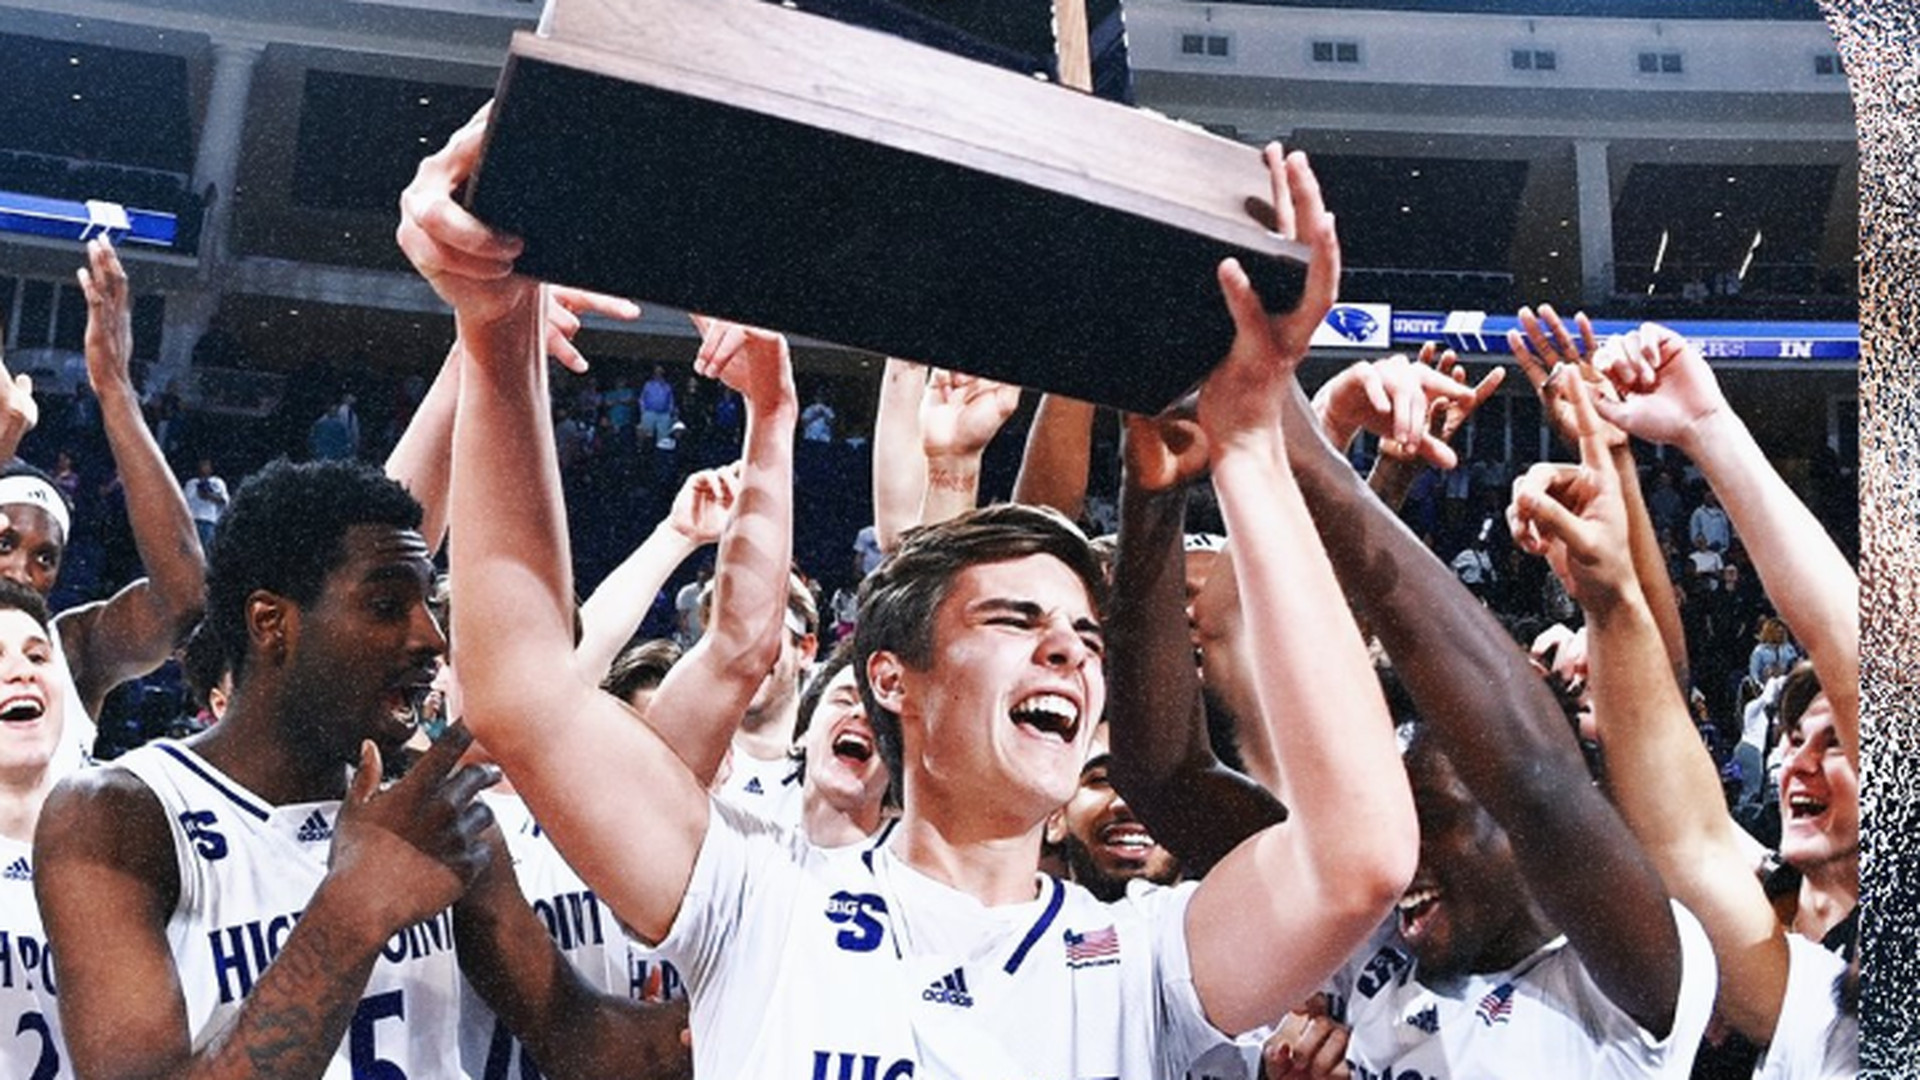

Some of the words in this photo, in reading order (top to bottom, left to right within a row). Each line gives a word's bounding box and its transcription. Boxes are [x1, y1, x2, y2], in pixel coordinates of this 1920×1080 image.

[1779, 341, 1812, 357] IN
[922, 988, 974, 1008] adidas
[350, 990, 407, 1080] 5
